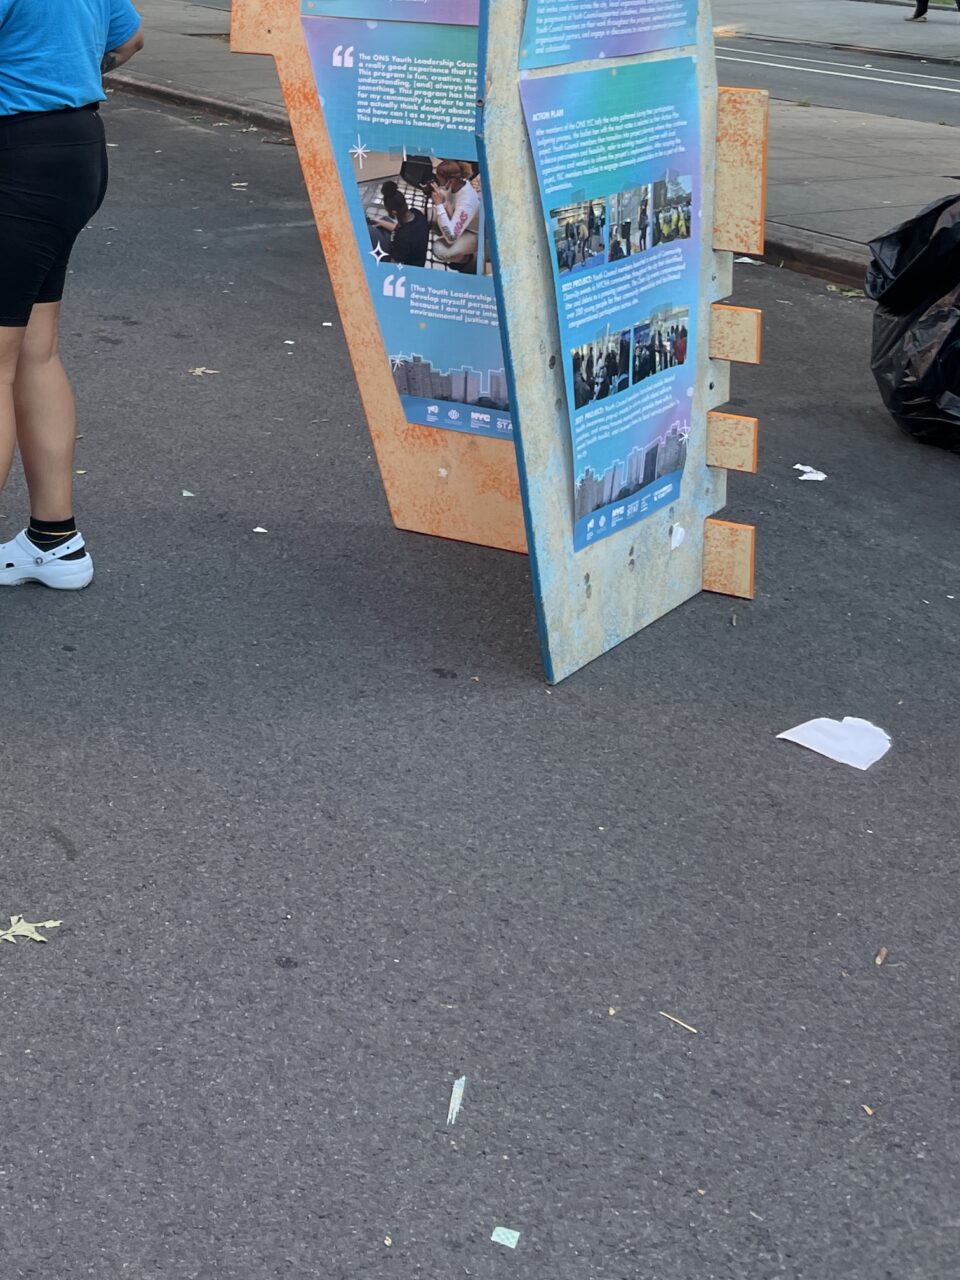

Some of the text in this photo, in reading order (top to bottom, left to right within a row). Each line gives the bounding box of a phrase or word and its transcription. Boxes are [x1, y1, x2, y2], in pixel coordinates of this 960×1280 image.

[414, 58, 454, 67] Leadership
[365, 62, 385, 70] really
[409, 66, 449, 74] experience
[431, 76, 463, 84] creative,
[358, 85, 396, 94] something.
[436, 83, 462, 91] always
[383, 95, 422, 104] community
[370, 101, 398, 110] actually
[421, 105, 446, 114] deeply
[428, 114, 450, 122] young
[533, 109, 564, 121] ACTION PLAN
[372, 117, 403, 125] program
[413, 119, 445, 130] honestly
[428, 287, 491, 302] Youth Leadership
[411, 293, 466, 306] develop myself
[410, 301, 440, 310] because
[410, 309, 463, 321] environmental
[497, 421, 513, 430] STA
